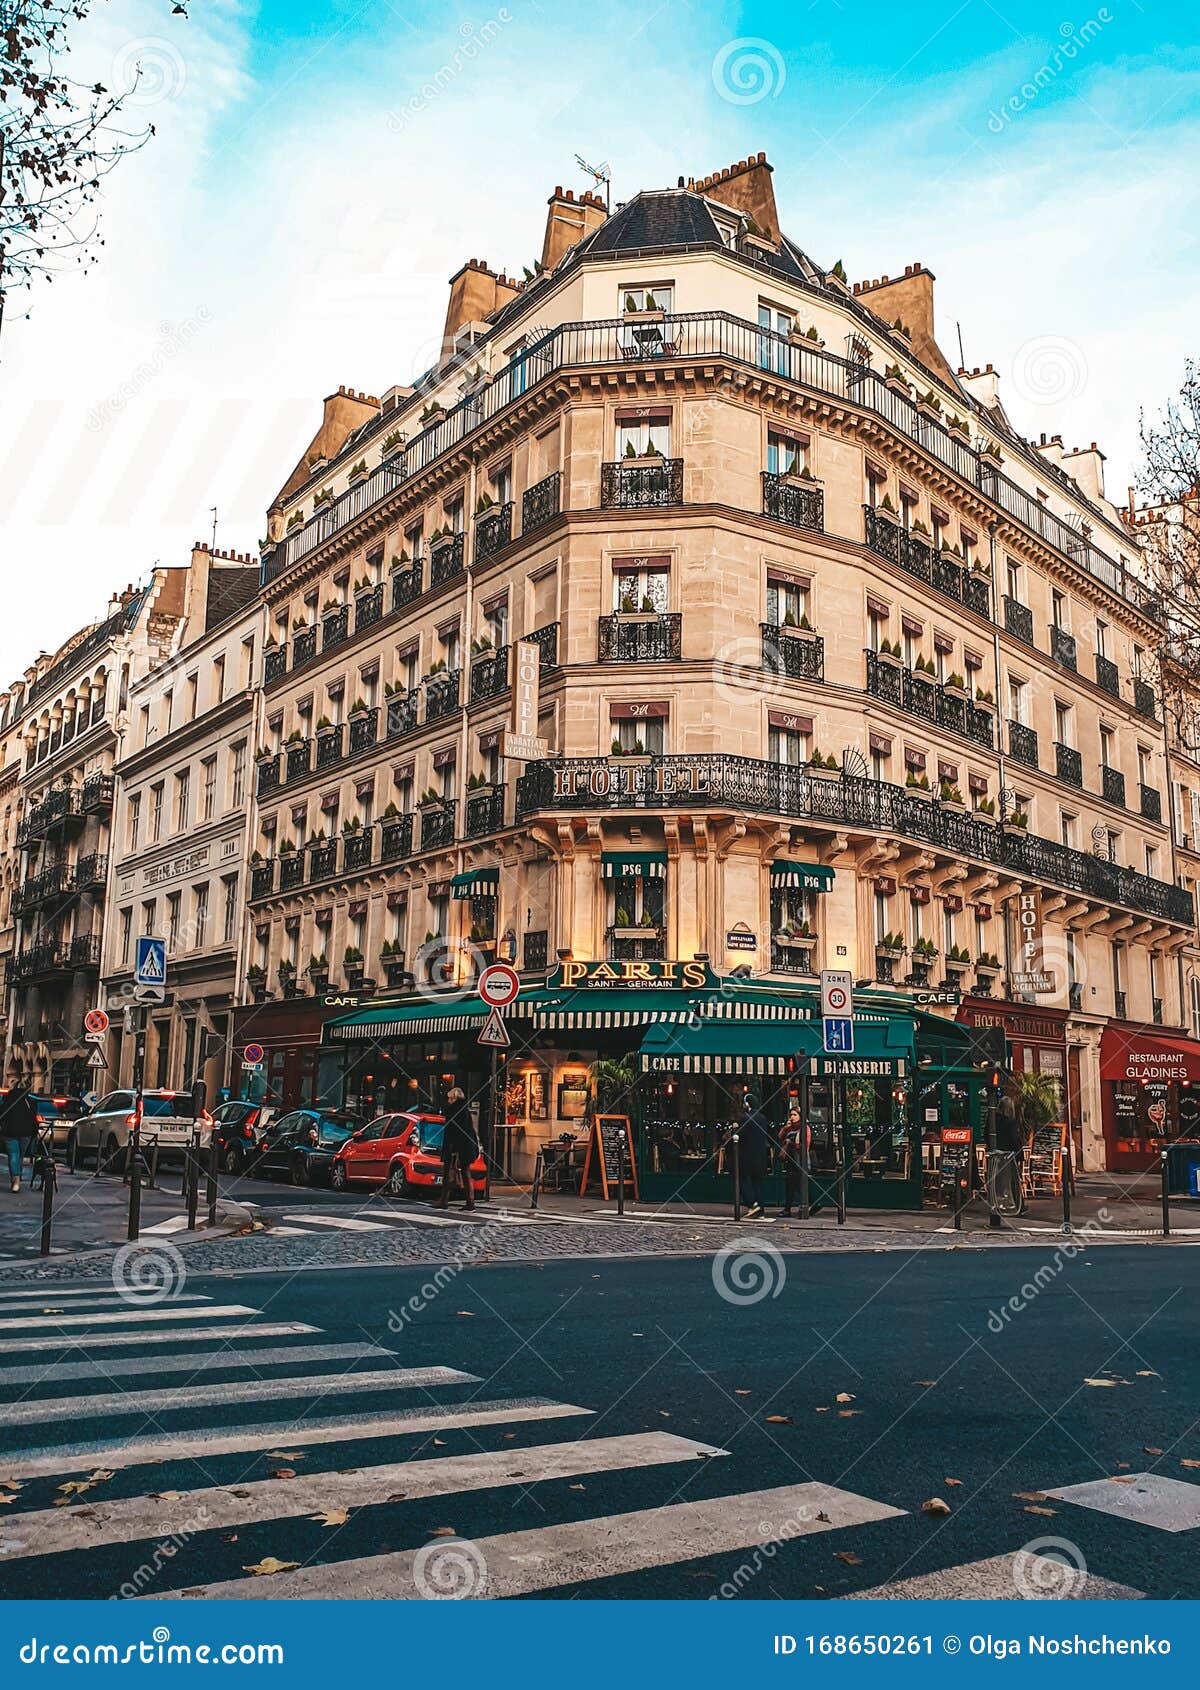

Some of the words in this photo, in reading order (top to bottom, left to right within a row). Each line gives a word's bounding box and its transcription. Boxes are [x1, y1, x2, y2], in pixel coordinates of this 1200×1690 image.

[519, 646, 537, 736] HOTEL
[554, 766, 710, 797] HOTEL
[622, 864, 641, 875] PSG
[804, 875, 819, 888] PSG
[1020, 895, 1037, 973] HOTEL
[837, 946, 846, 955] 46
[559, 962, 706, 988] PARIS
[827, 975, 846, 983] ZONE
[324, 997, 358, 1007] CAFE
[832, 995, 843, 1003] 30
[918, 993, 955, 1004] CAFE
[973, 1014, 1006, 1029] HOTEL
[1012, 1018, 1058, 1036] ABBATIAL
[652, 1058, 680, 1071] CAFE
[1129, 1054, 1184, 1063] RESTAURANT
[824, 1060, 892, 1075] BRASSERIE
[1126, 1067, 1188, 1078] GLADINES
